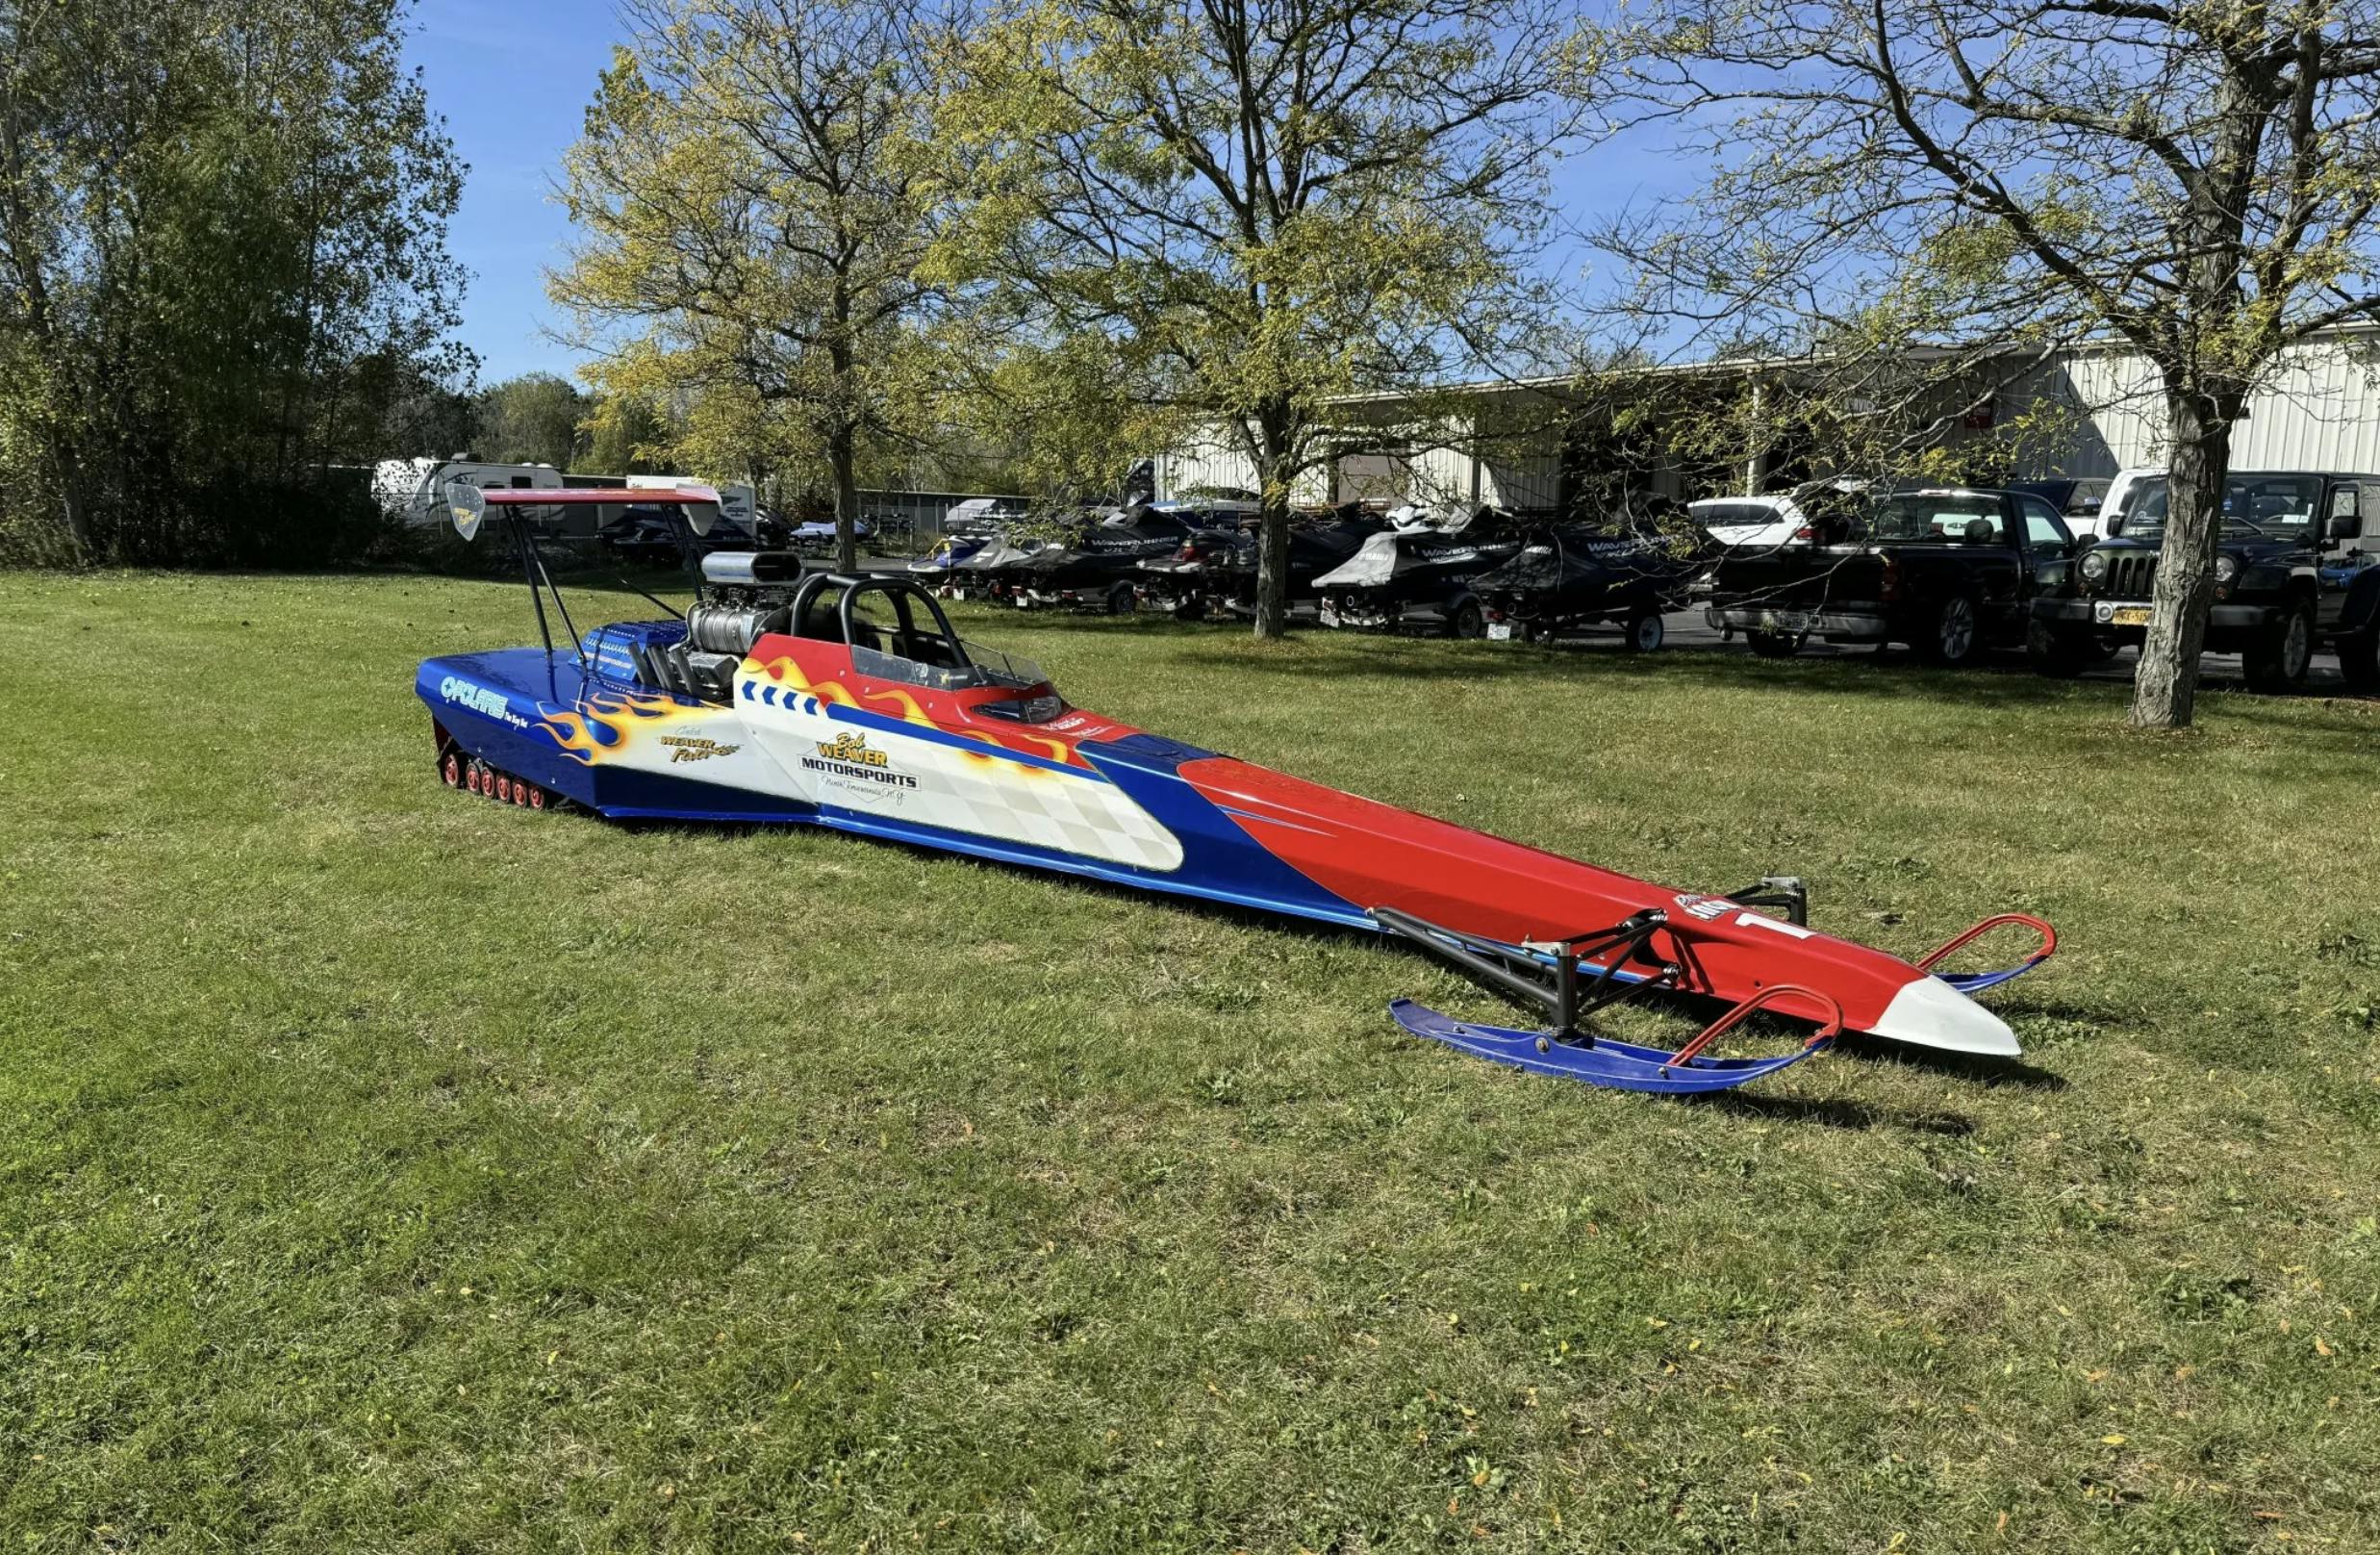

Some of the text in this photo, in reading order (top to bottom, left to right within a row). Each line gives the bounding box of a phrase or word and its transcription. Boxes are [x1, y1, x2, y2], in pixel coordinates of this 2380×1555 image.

[660, 735, 716, 750] WEAVER
[836, 732, 866, 750] Bob
[816, 741, 889, 769] WEAVER
[801, 756, 917, 789] MOTORSPORTS
